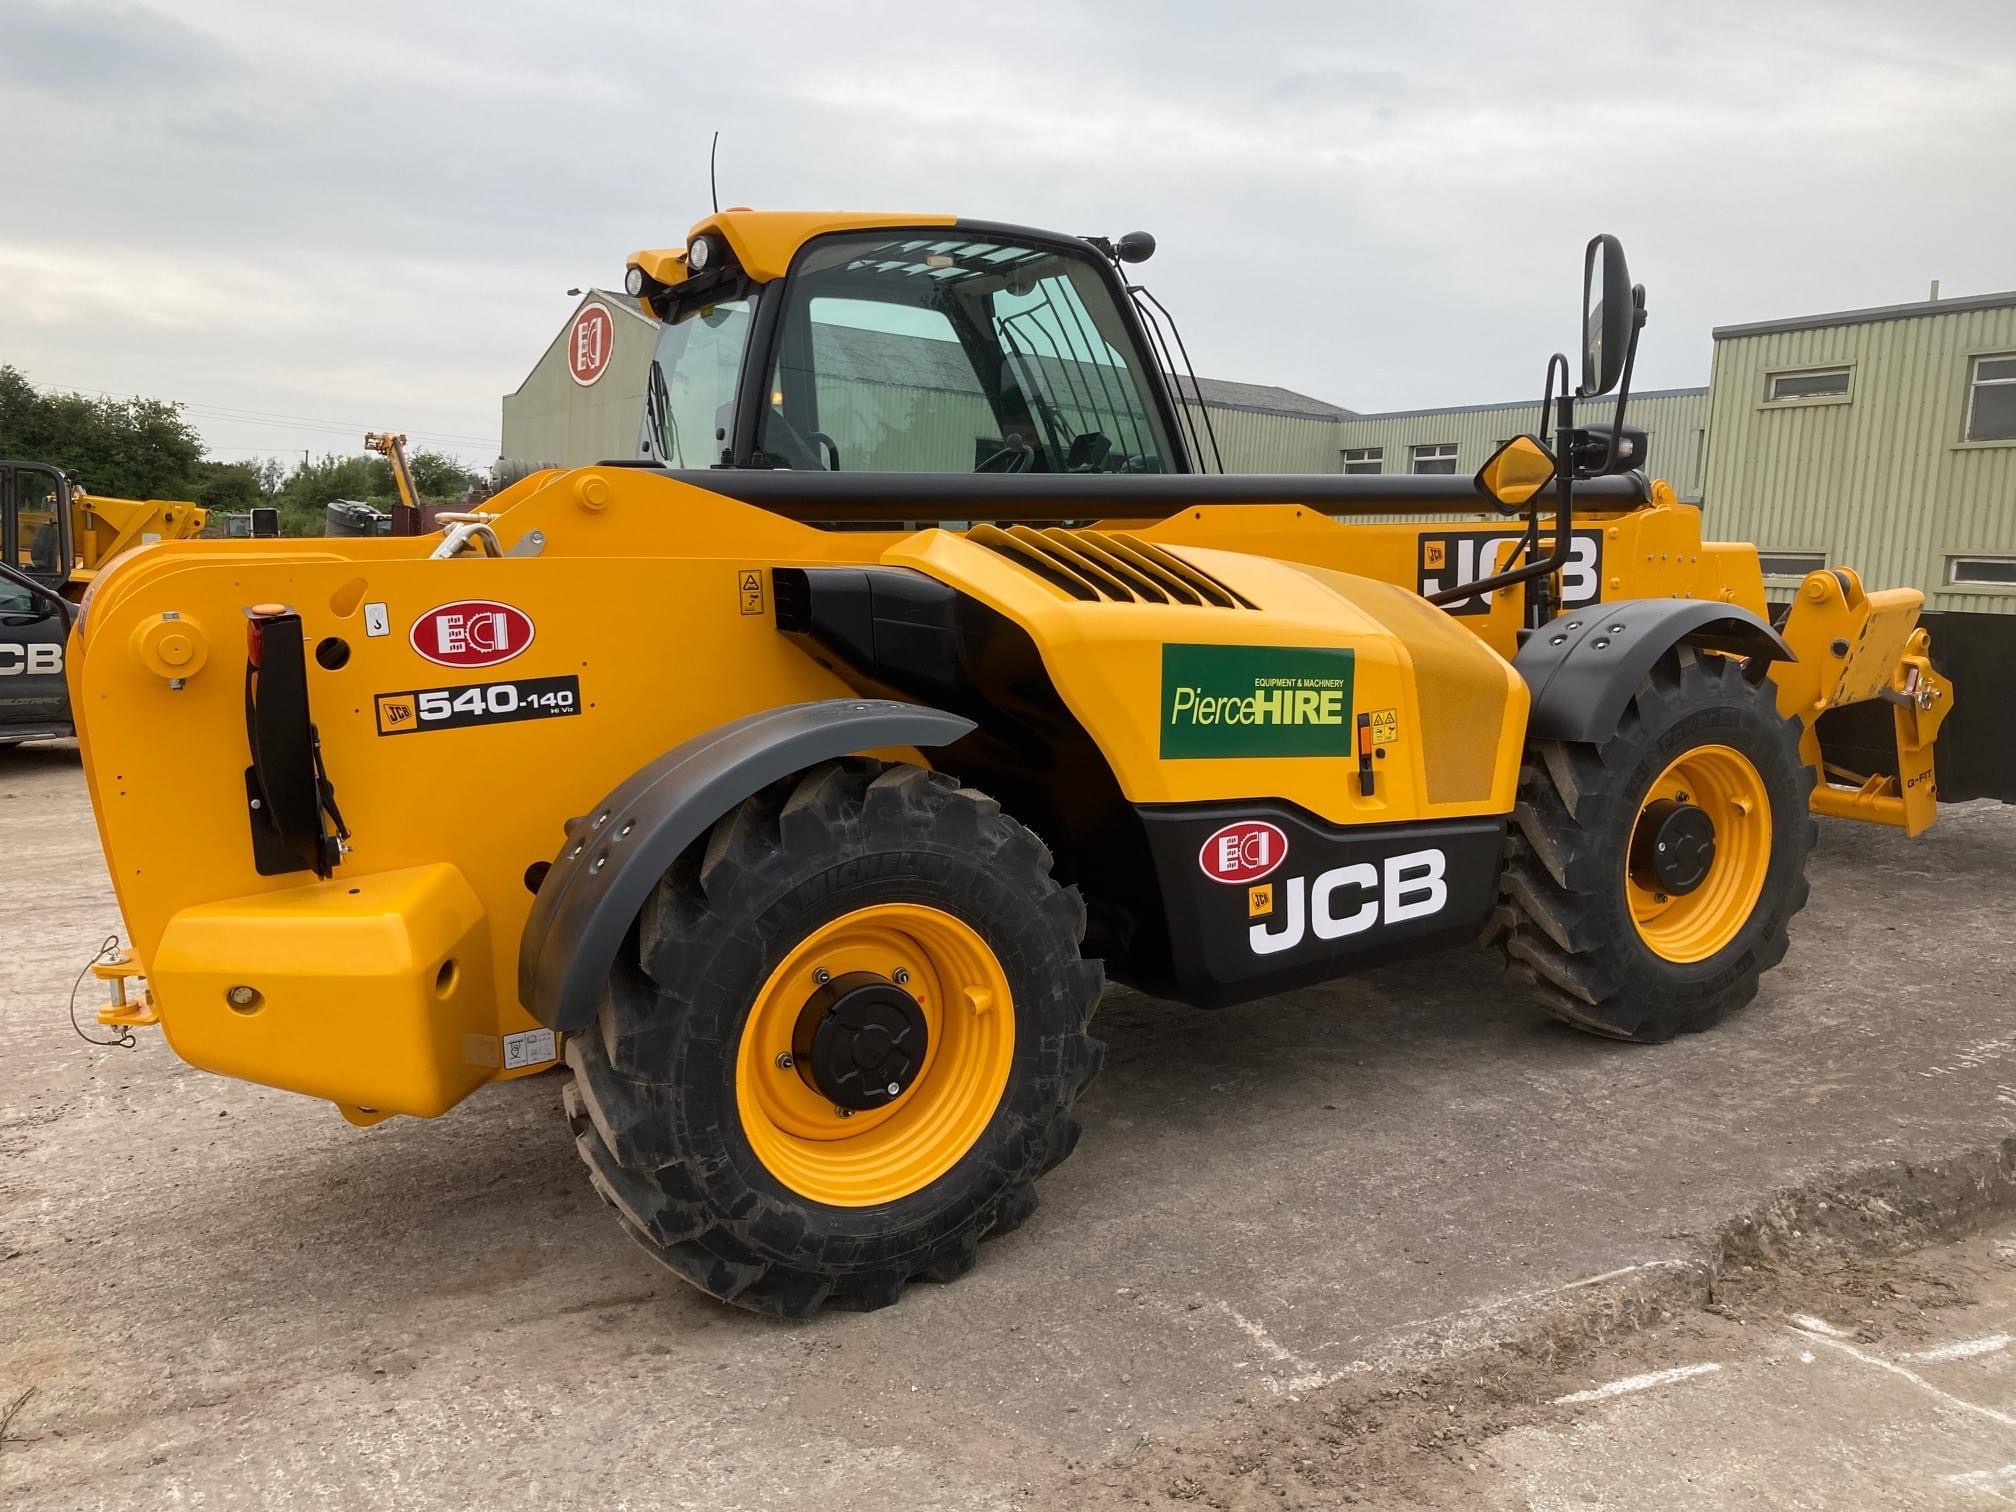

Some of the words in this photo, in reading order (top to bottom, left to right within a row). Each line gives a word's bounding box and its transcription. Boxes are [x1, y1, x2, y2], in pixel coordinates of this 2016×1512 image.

[577, 317, 603, 371] ECI
[436, 612, 509, 654] ECI
[1255, 678, 1297, 688] EQUIPMENT
[1297, 678, 1303, 688] &
[1303, 679, 1344, 688] MACHINERY
[388, 704, 412, 724] JCB
[1219, 831, 1270, 873] ECI
[1249, 848, 1448, 955] JCB
[1254, 891, 1271, 908] JCB
